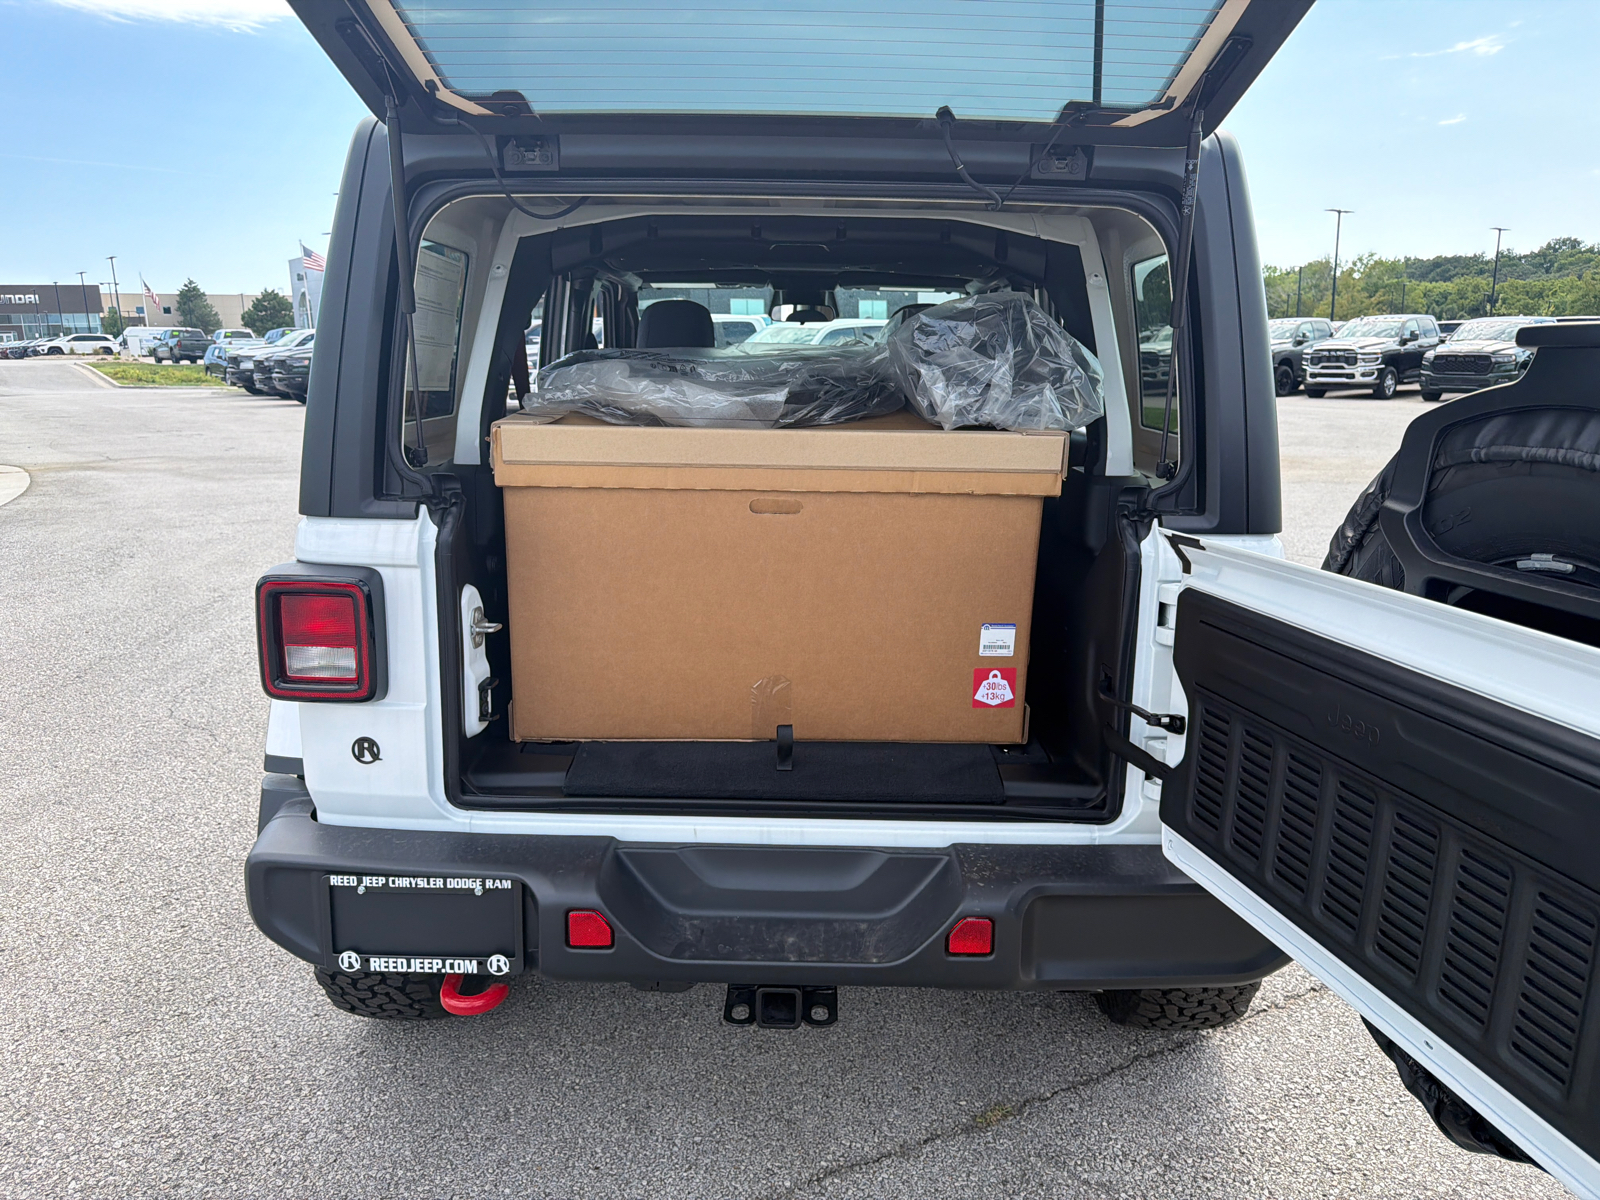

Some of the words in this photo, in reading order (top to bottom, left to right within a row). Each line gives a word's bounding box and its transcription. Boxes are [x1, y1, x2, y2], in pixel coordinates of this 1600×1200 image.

[983, 682, 1007, 691] +30lbs
[981, 692, 1005, 702] +13kg
[1326, 703, 1380, 748] Jeep
[330, 875, 357, 886] REED
[360, 876, 386, 887] JEEP
[389, 877, 444, 888] CHRYSLER
[447, 878, 483, 889] DODGE
[485, 879, 512, 889] RAM
[370, 957, 477, 973] REEDJEEP.COM
